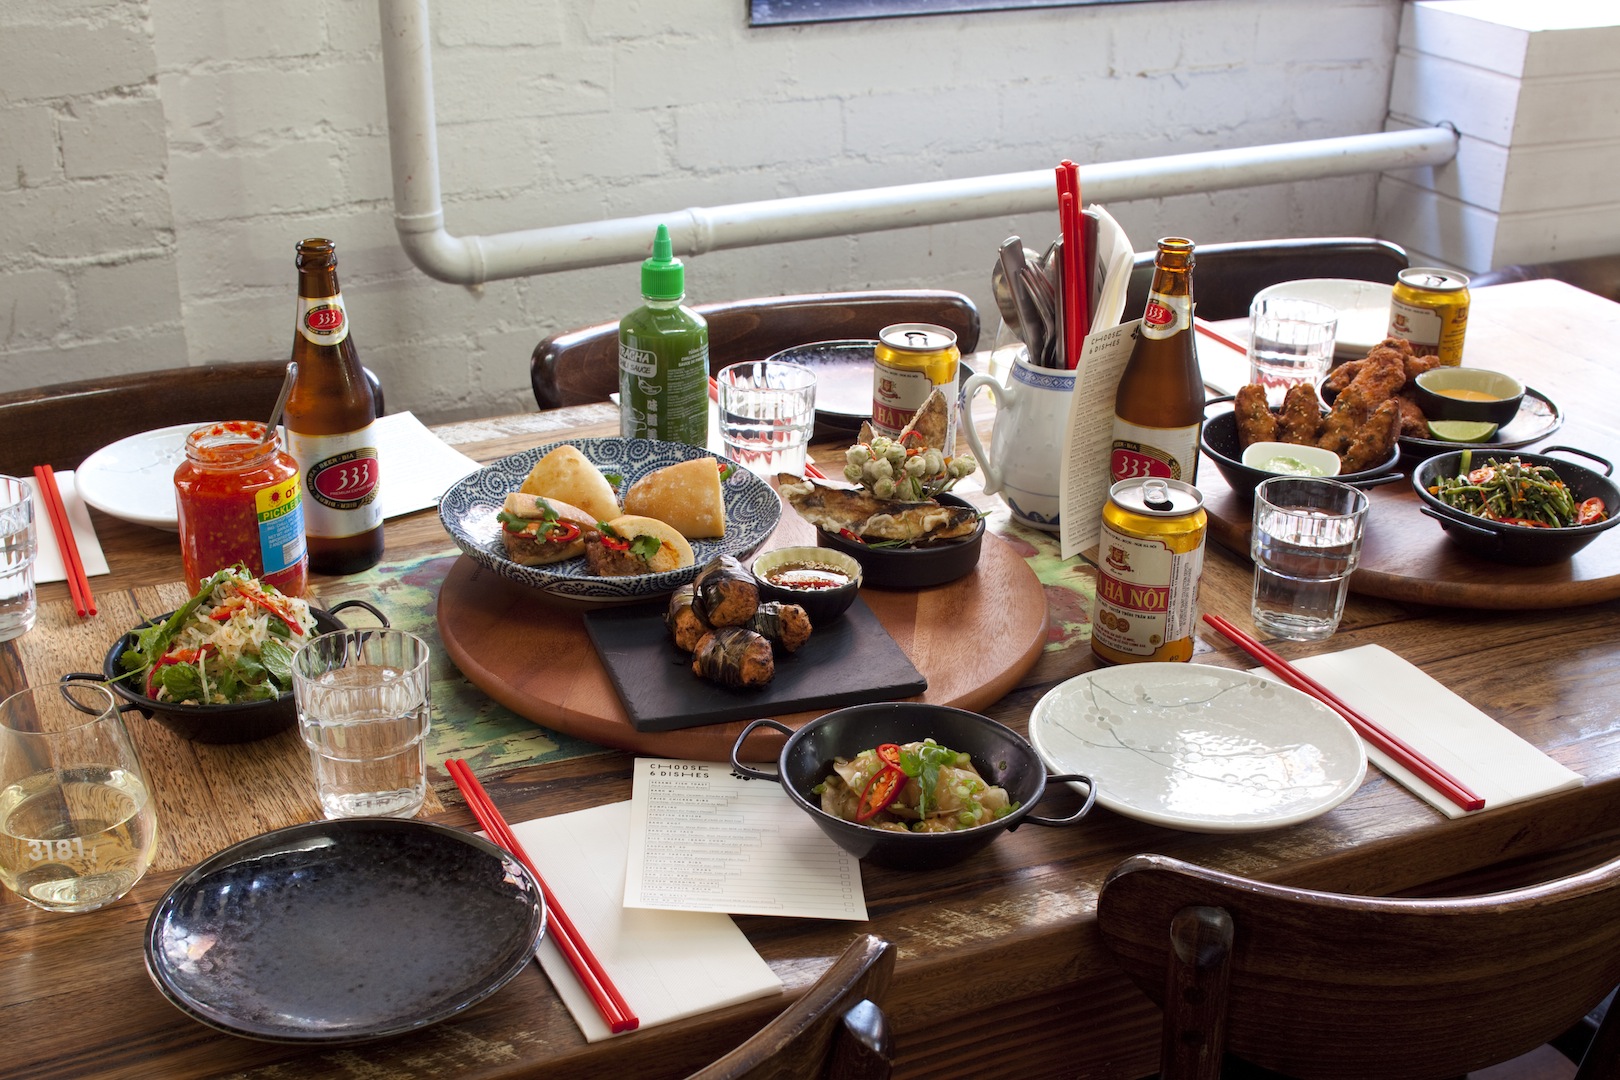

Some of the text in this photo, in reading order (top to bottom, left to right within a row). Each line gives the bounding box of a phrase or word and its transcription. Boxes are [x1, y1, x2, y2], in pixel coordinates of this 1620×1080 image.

[318, 312, 336, 325] 333
[1148, 306, 1163, 319] 333
[1091, 329, 1122, 345] CHOOSE
[1094, 339, 1120, 352] DISHES
[630, 363, 651, 374] SAUCE
[319, 458, 338, 468] BEER
[1118, 456, 1150, 477] 333
[336, 464, 369, 491] 333
[1104, 579, 1125, 603] HÀ
[1129, 588, 1166, 611] NỘI
[650, 763, 709, 771] CHOOSE
[660, 771, 709, 779] DISHES
[28, 837, 84, 861] 3181
